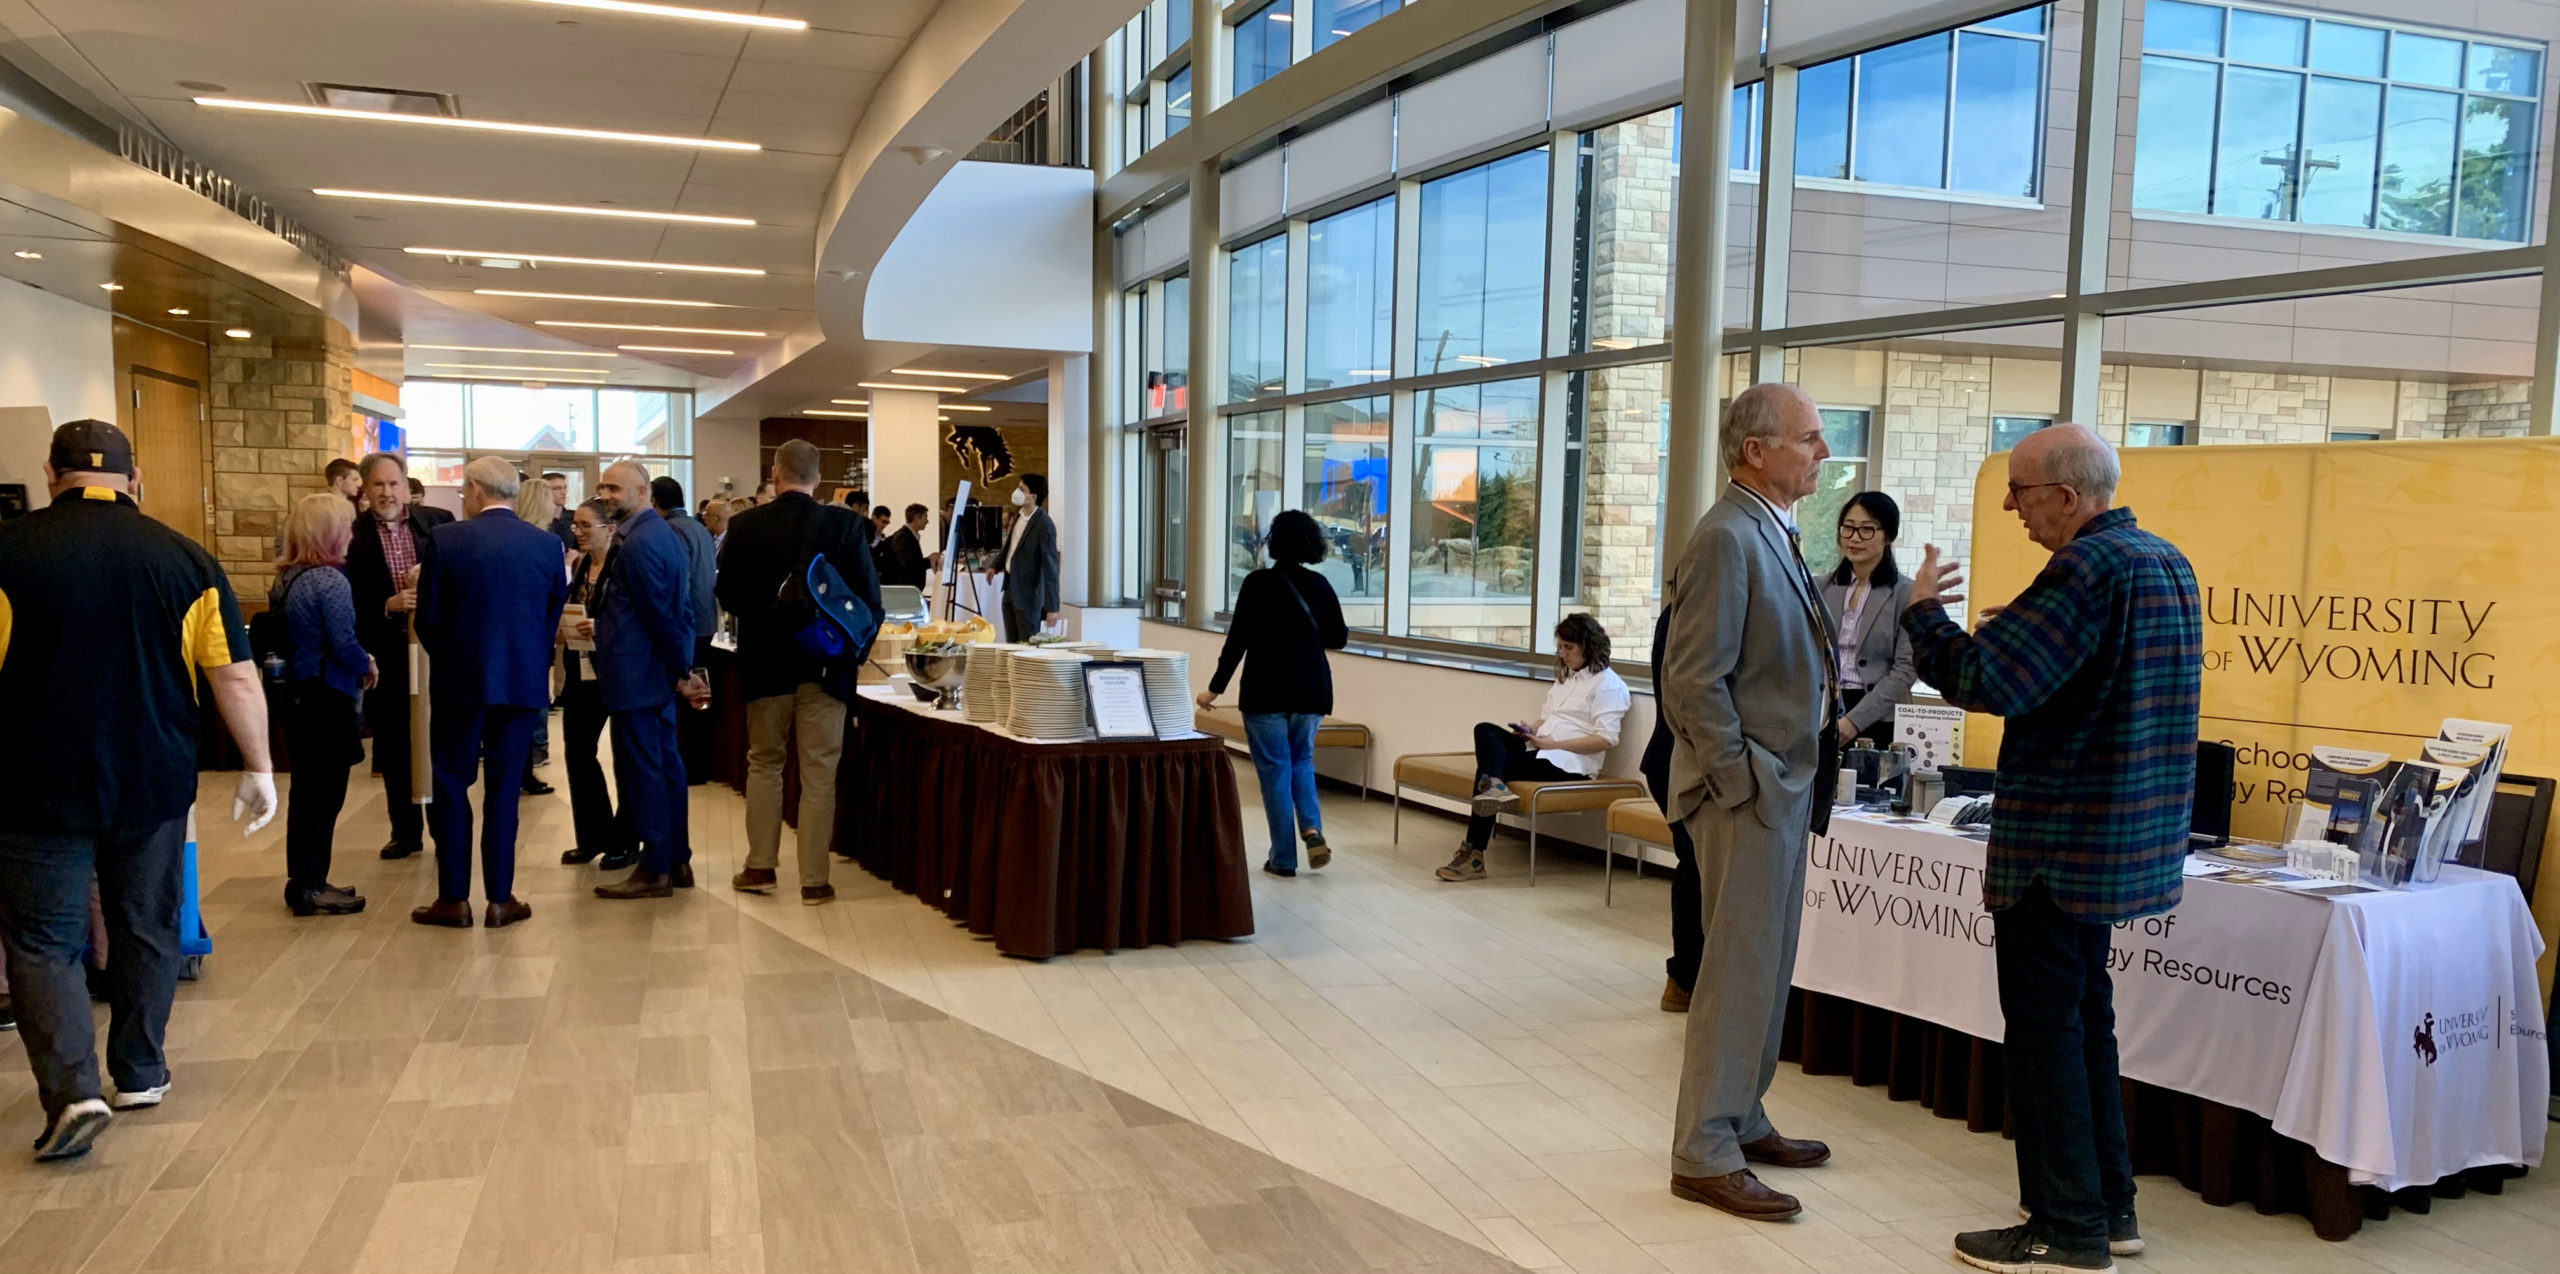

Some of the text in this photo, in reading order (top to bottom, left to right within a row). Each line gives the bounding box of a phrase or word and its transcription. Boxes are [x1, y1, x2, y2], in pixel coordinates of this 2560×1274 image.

[119, 121, 241, 214] UNIVERSITY
[249, 195, 267, 228] OF
[2207, 586, 2498, 644] UNIVERSITY
[2202, 635, 2496, 689] OF WYOMING
[1897, 706, 1963, 717] COAL-TO-PRODUCTS
[2219, 739, 2311, 771] choo
[1805, 878, 1996, 948] OF WYOMING
[2144, 914, 2177, 939] of
[2143, 948, 2293, 1005] Resources
